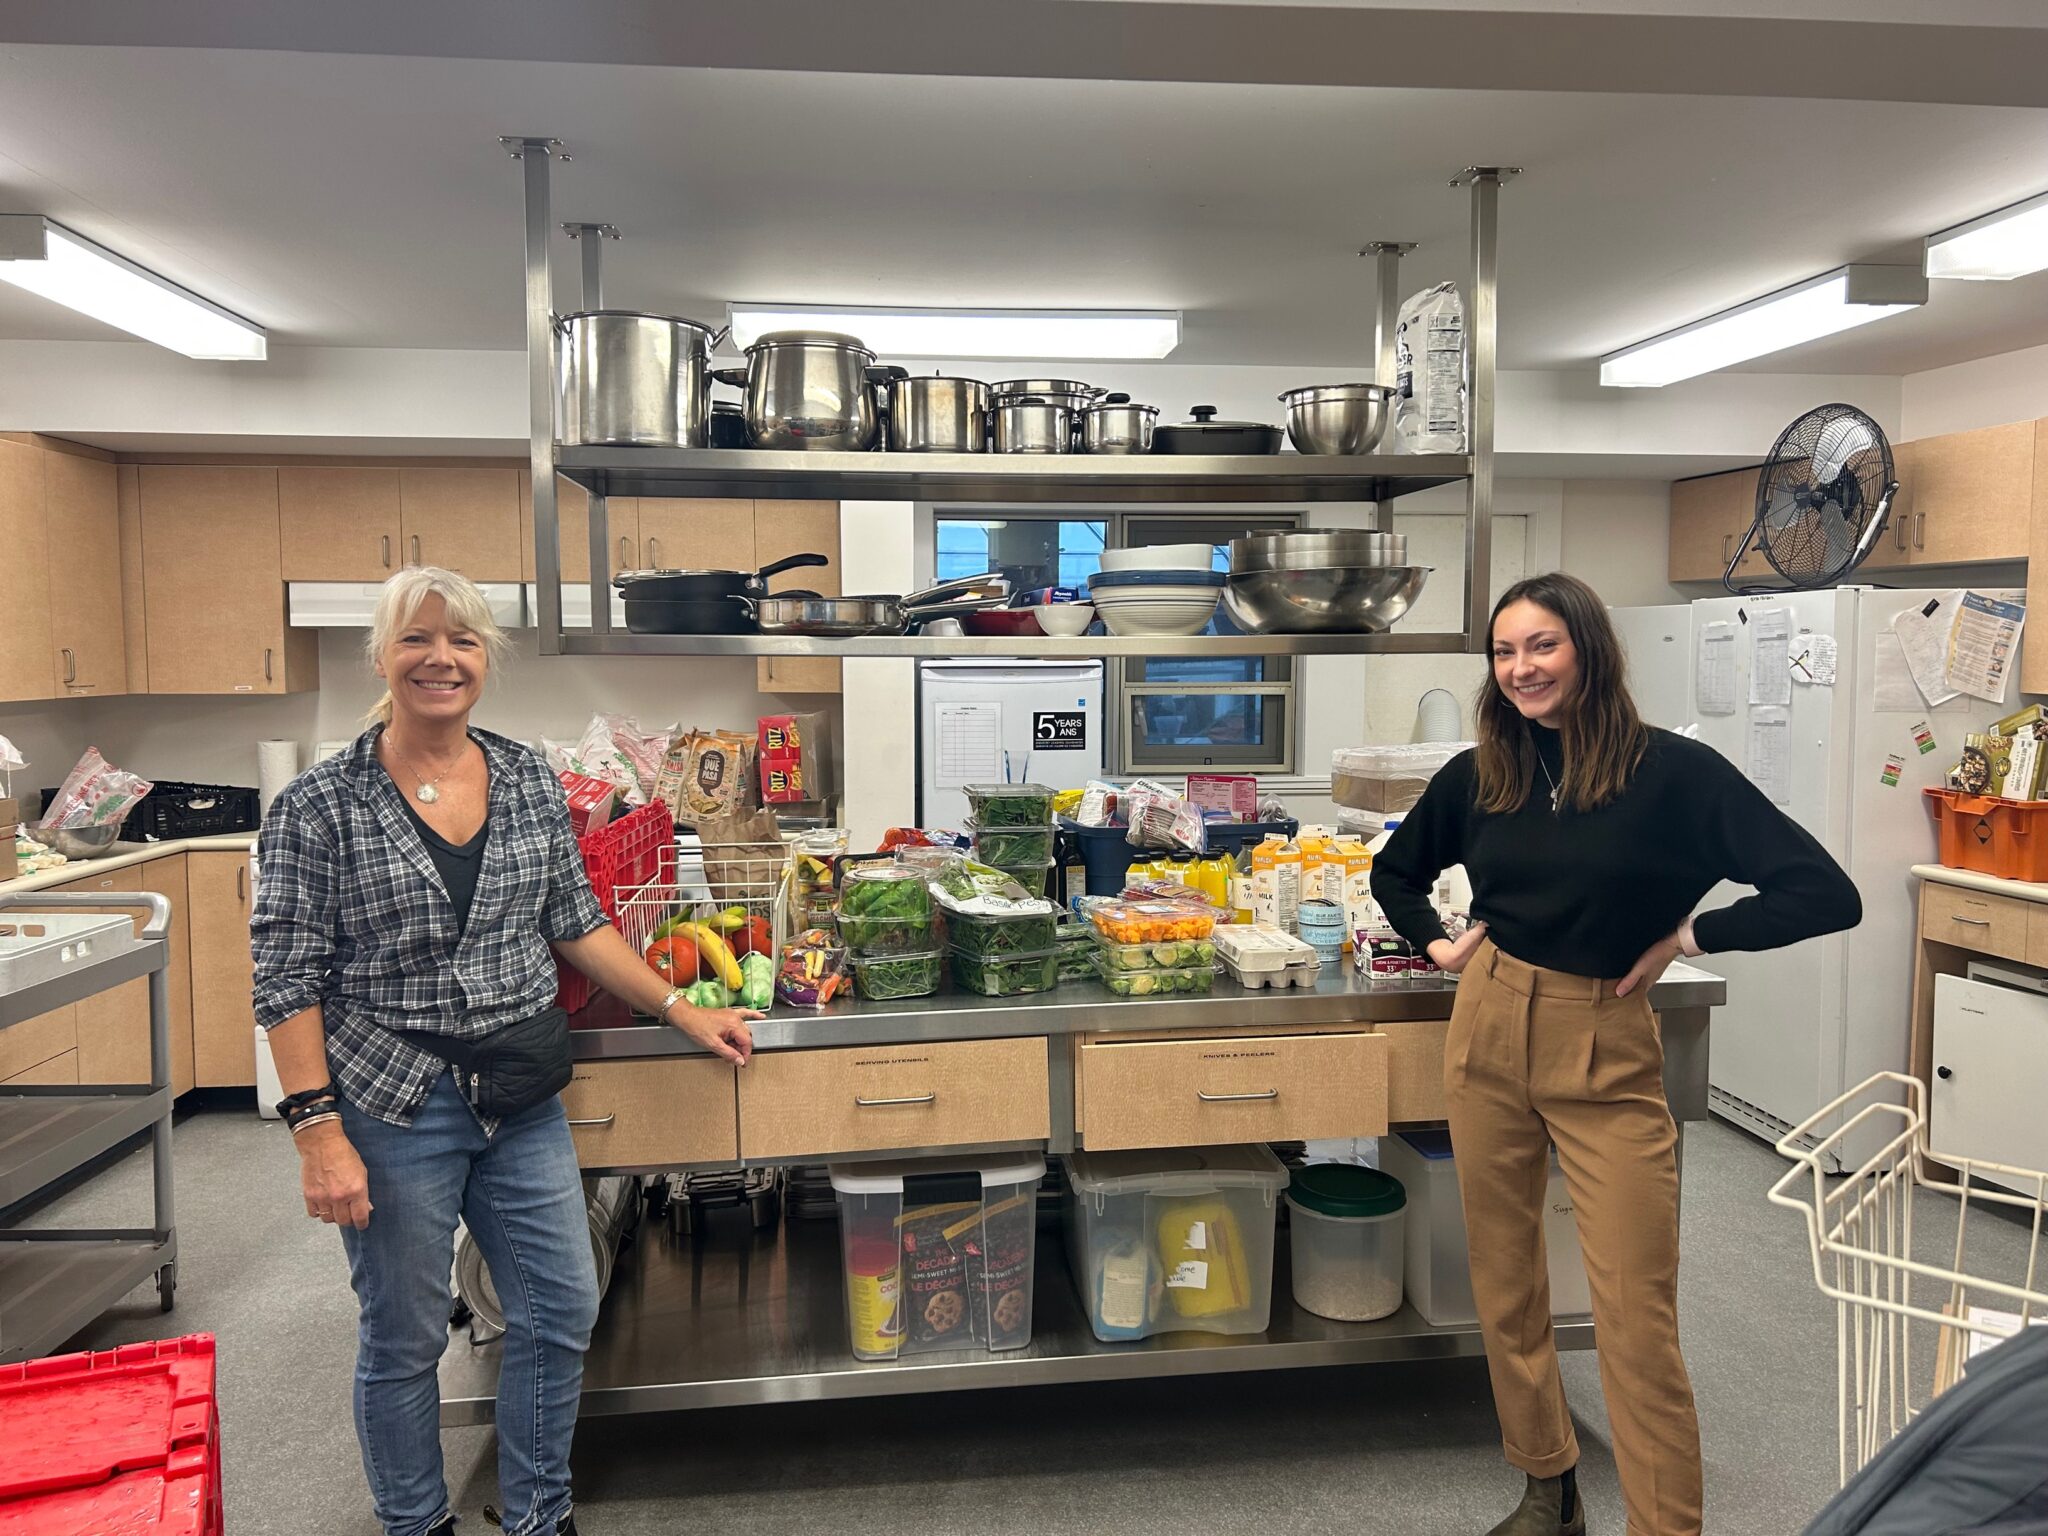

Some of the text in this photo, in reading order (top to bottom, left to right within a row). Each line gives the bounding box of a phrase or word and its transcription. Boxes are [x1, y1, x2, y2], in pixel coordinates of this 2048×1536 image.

[1037, 714, 1082, 738] 5 YEARS
[1059, 728, 1077, 736] ANS
[768, 728, 782, 749] RITZ
[704, 759, 720, 771] QUE
[702, 770, 718, 780] PASA
[770, 770, 785, 792] RITZ
[1258, 892, 1273, 900] MILK
